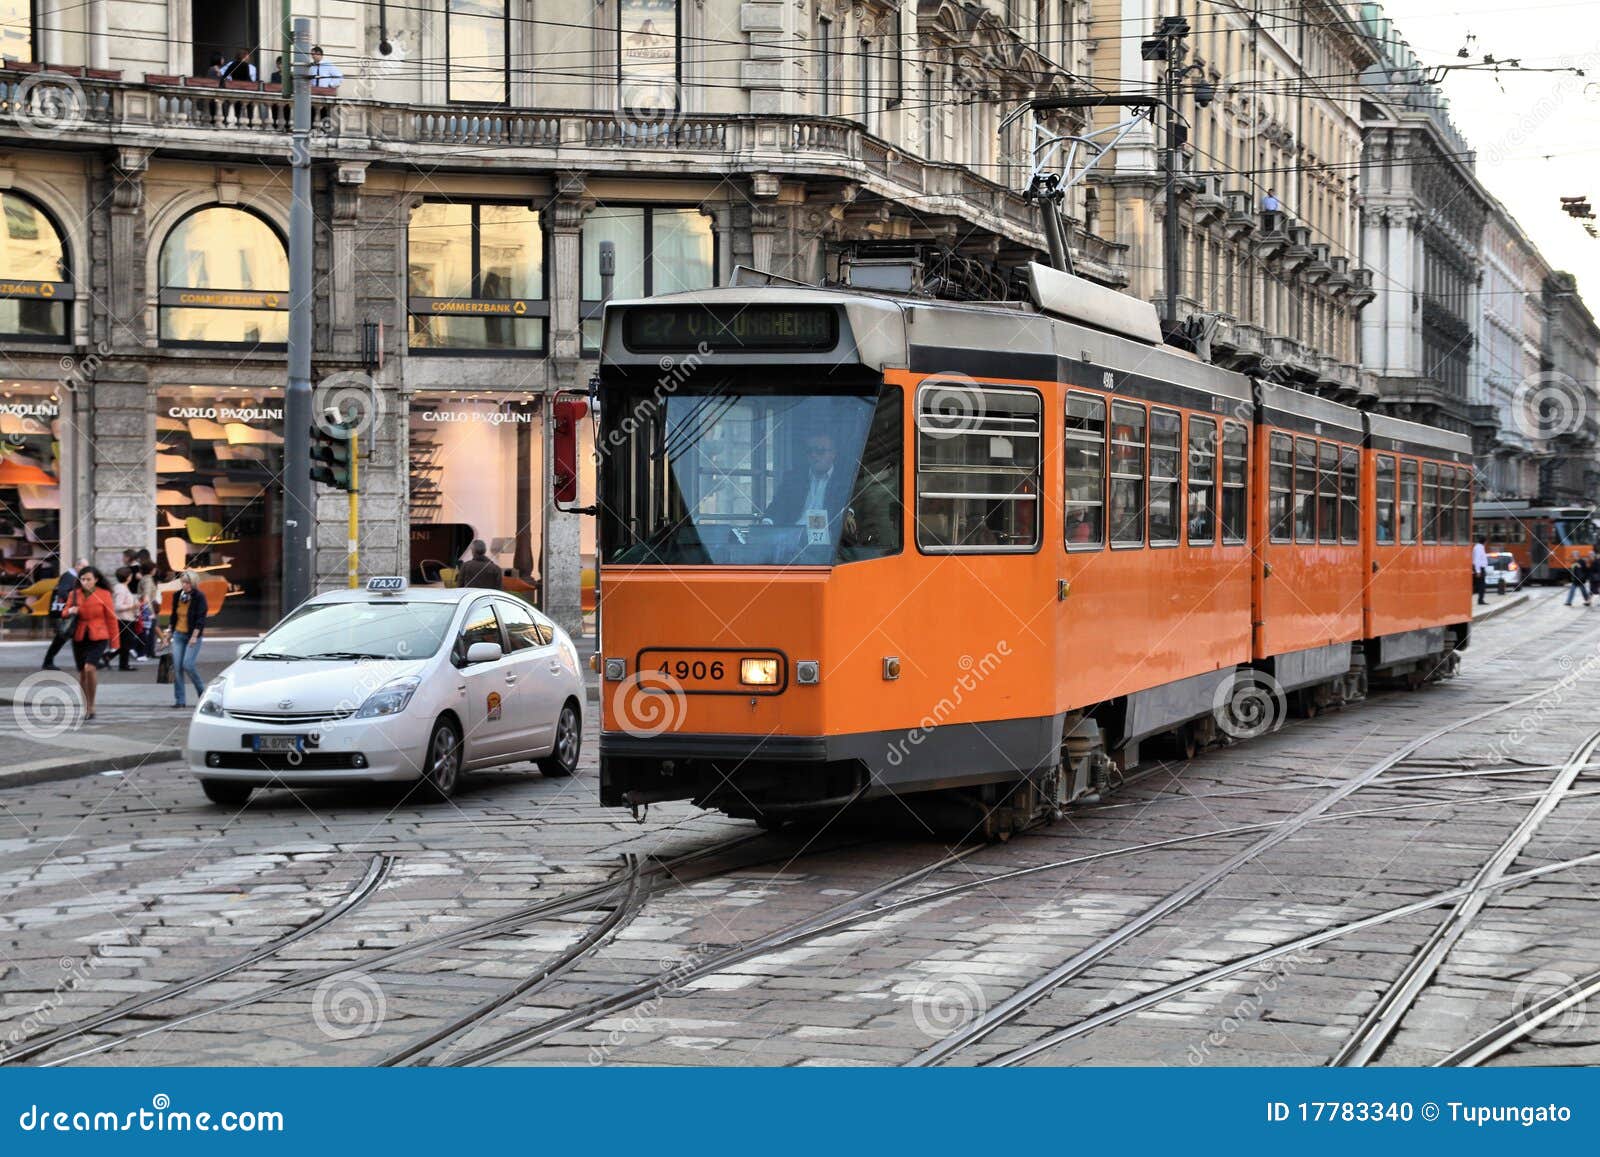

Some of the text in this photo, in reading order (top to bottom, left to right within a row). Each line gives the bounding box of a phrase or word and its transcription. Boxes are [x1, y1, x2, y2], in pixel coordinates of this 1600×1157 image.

[432, 302, 511, 313] COMMERZBANK
[168, 407, 283, 422] CARLO PAZOLINI
[422, 411, 532, 425] CARLO PAZOLINI
[372, 579, 401, 588] TAXI
[658, 660, 724, 680] 4906
